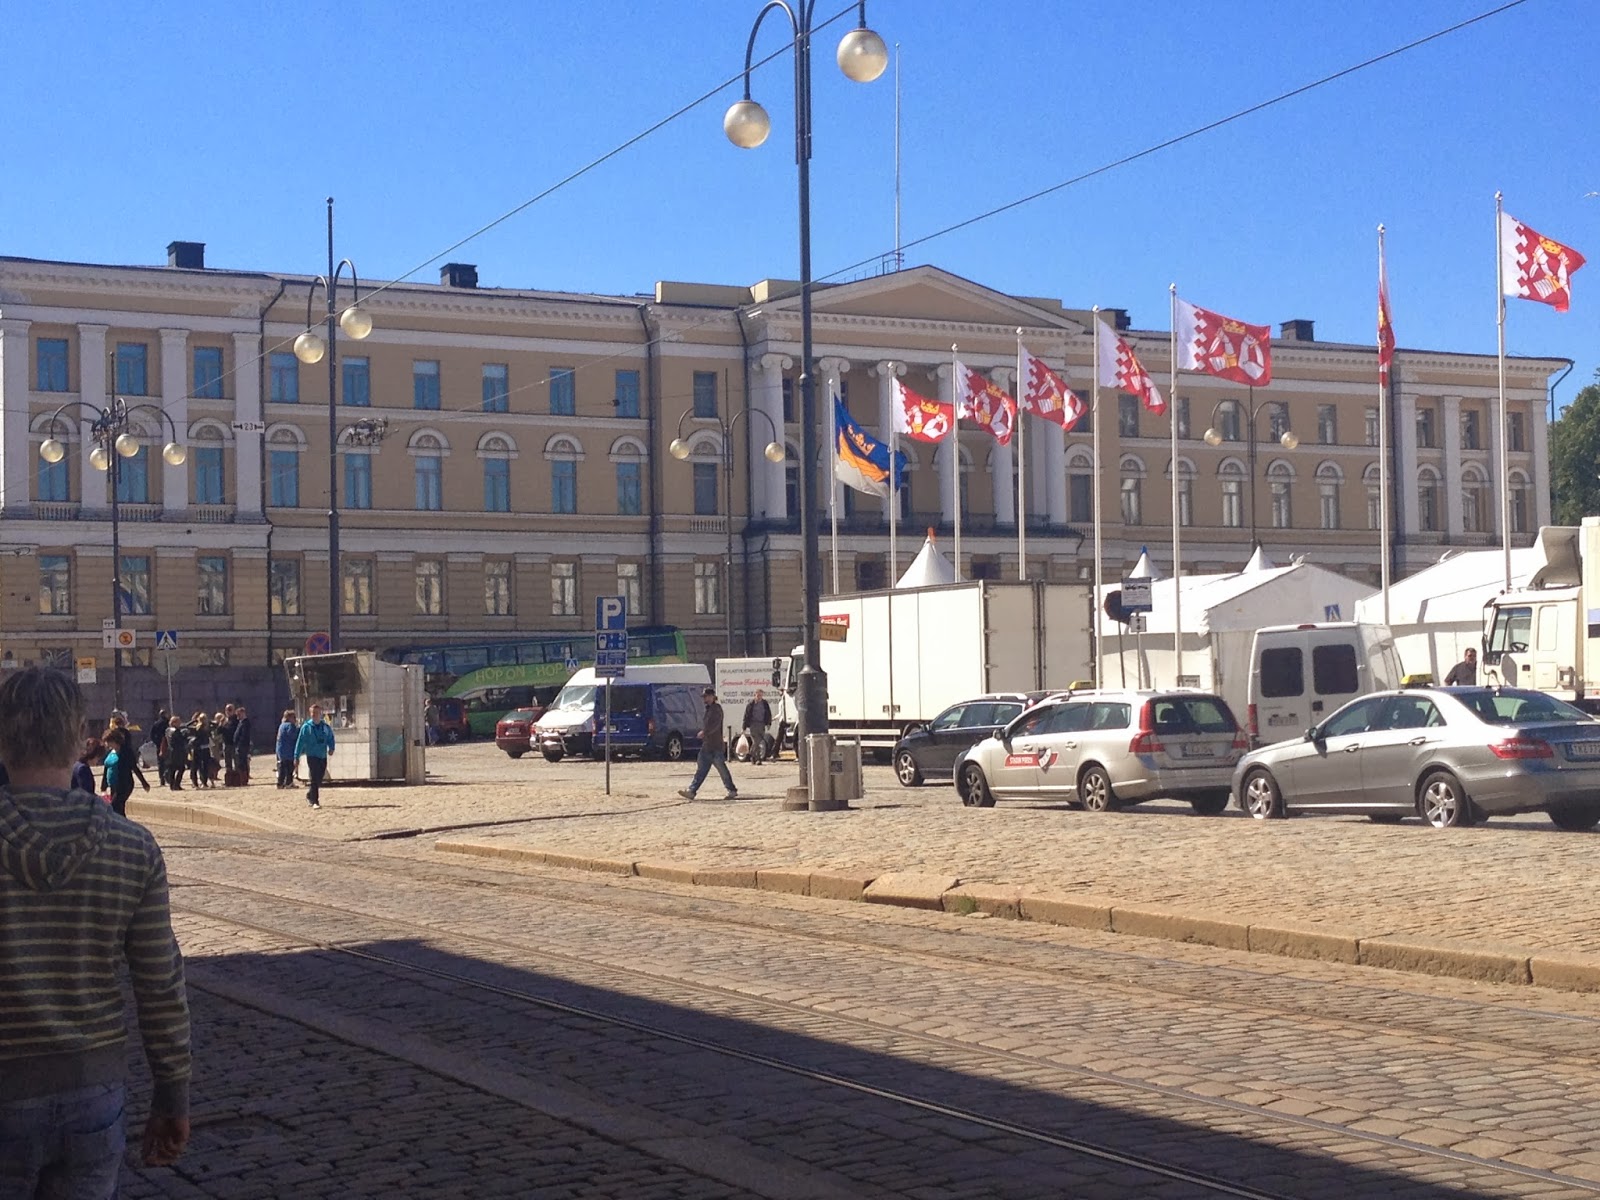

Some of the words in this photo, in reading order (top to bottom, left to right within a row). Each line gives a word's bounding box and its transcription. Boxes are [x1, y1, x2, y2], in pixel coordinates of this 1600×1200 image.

[244, 422, 253, 431] 23
[602, 598, 622, 629] P
[476, 667, 503, 681] HOP
[505, 665, 526, 678] ON
[536, 663, 563, 676] HOP
